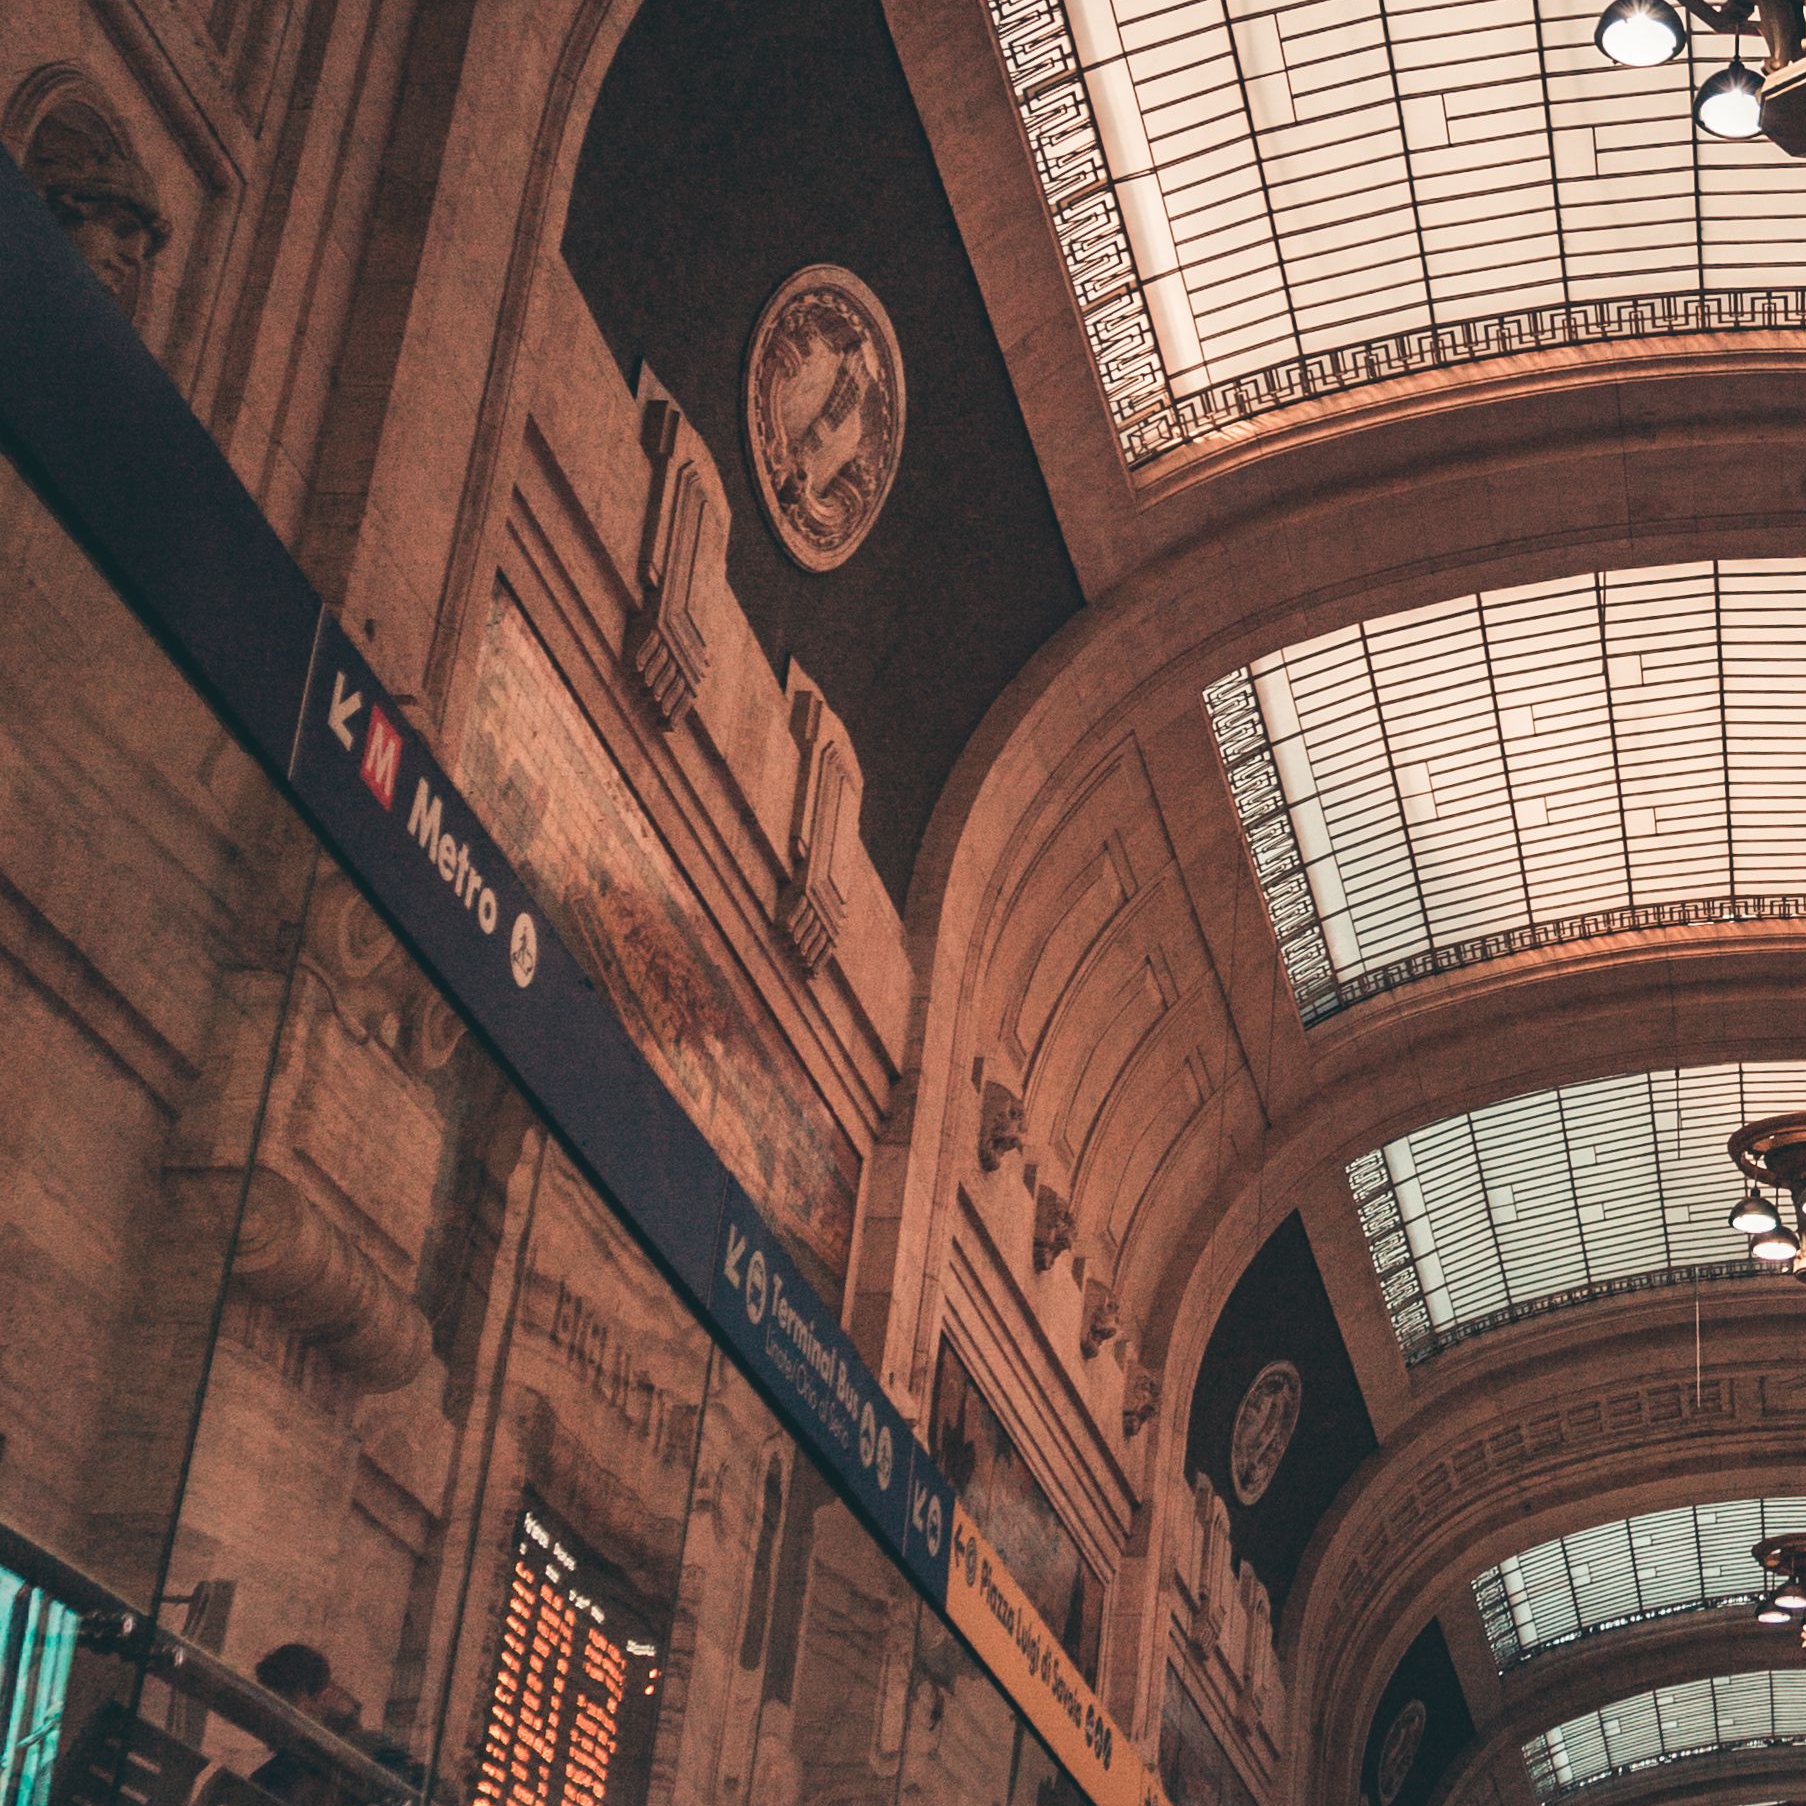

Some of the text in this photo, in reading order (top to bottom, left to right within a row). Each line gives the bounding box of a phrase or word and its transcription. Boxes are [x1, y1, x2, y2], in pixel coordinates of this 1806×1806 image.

[365, 722, 498, 936] M Metro
[771, 1272, 860, 1422] Terminal Bus
[979, 1557, 1082, 1729] Piazza Luigi di Savoia
